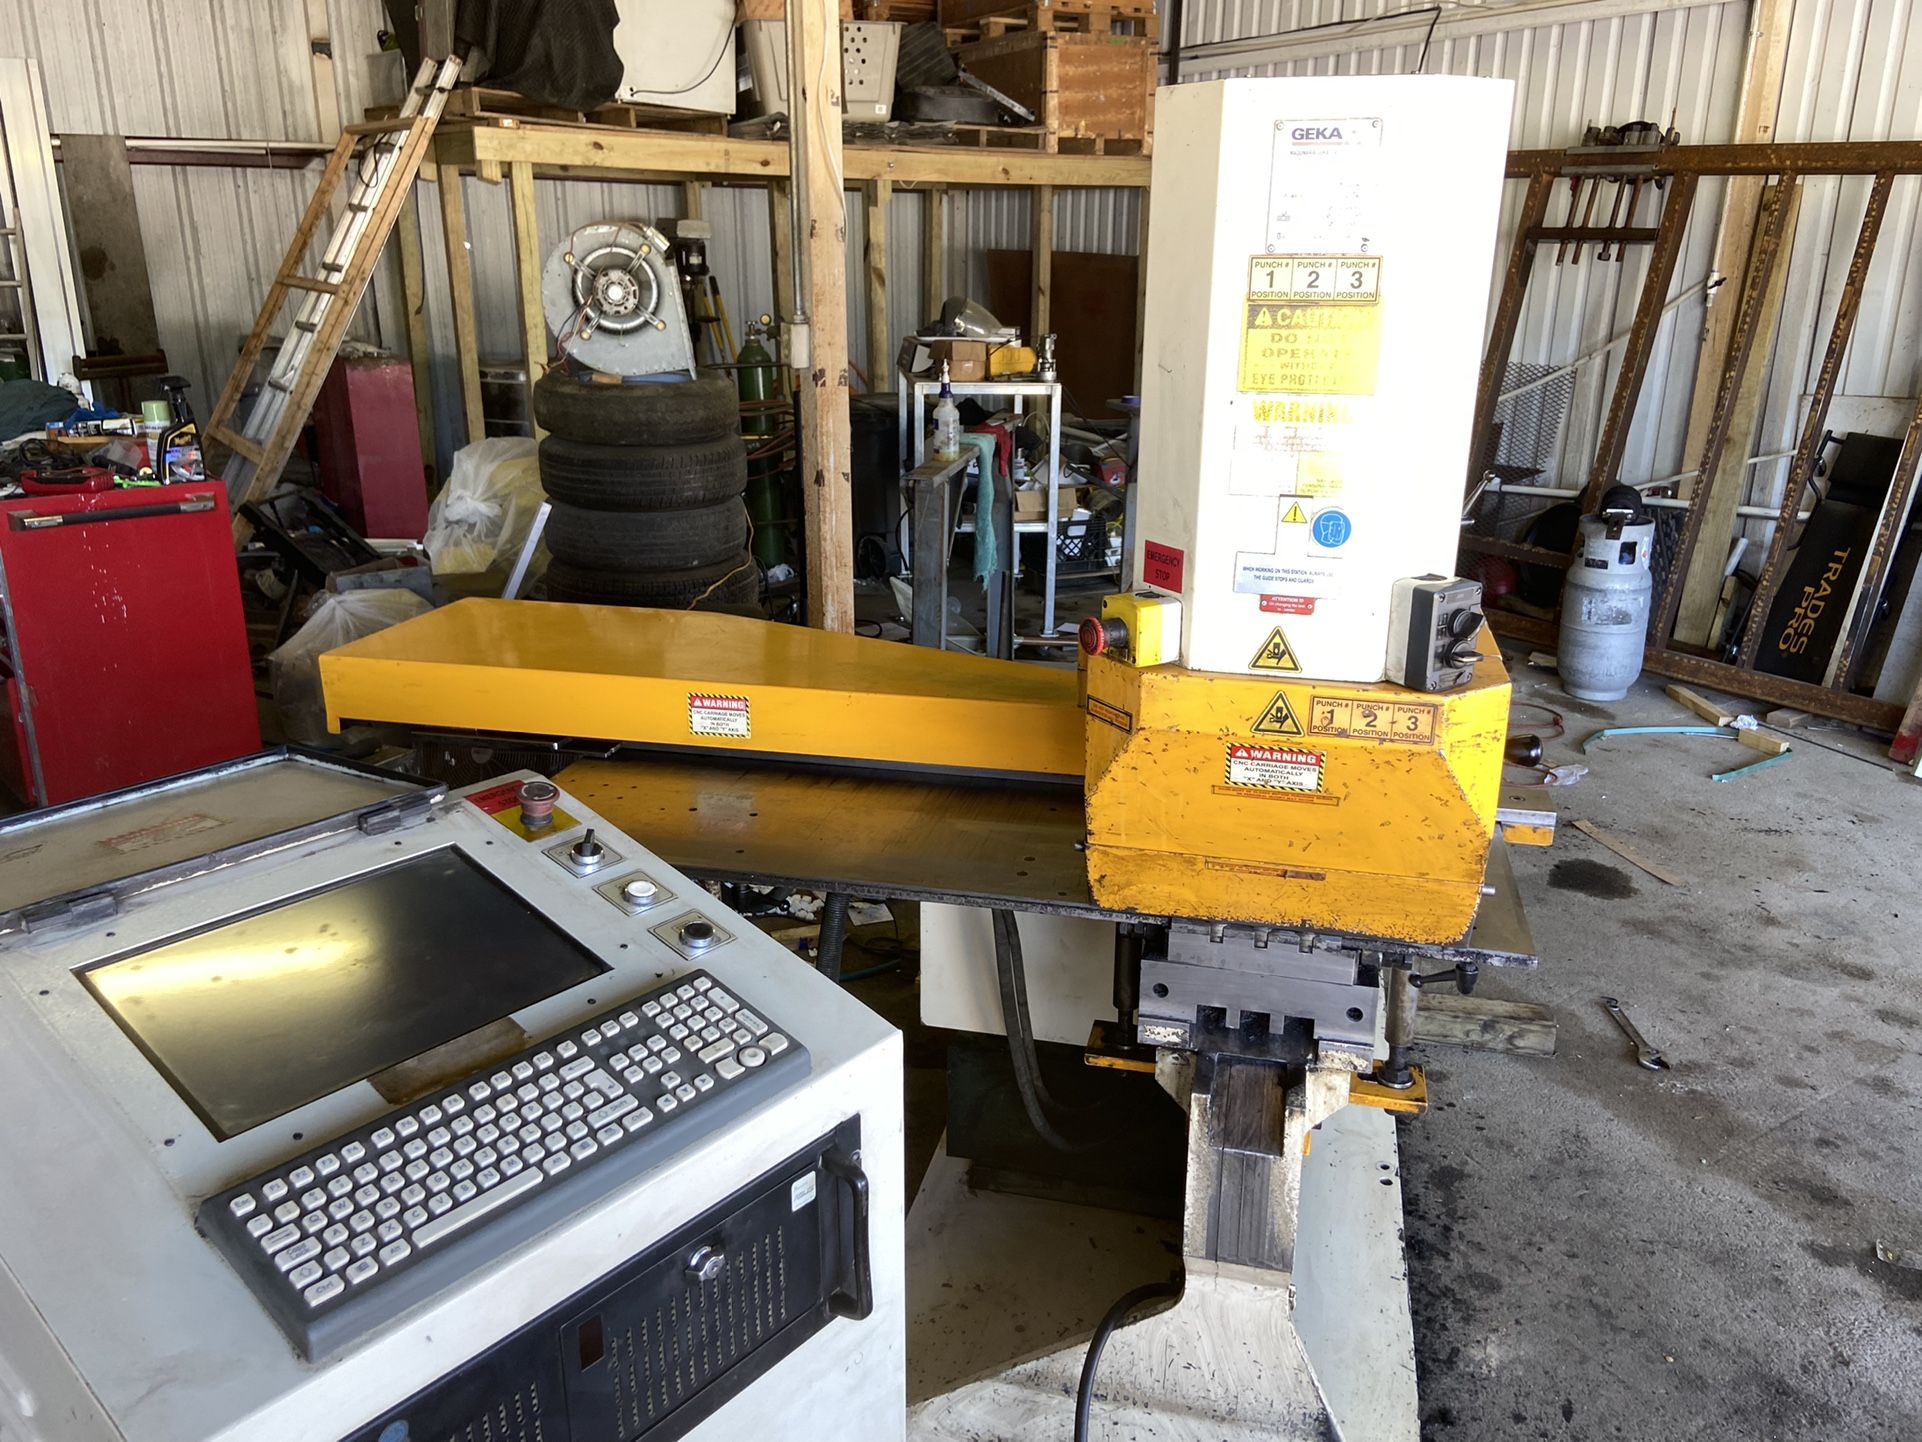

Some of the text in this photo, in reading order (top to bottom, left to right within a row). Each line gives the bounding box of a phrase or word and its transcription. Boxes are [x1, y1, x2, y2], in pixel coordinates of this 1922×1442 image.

[1292, 127, 1343, 140] GEKA
[1254, 261, 1283, 269] PUNCH
[1297, 261, 1326, 269] PUNCH
[1340, 261, 1369, 269] PUNCH
[1266, 270, 1274, 288] 1
[1307, 270, 1320, 288] 2
[1350, 270, 1363, 289] 3
[1251, 291, 1289, 299] POSITION
[1293, 291, 1332, 299] POSITION
[1146, 549, 1180, 568] EMERGENCY
[1155, 568, 1170, 582] STOP
[1788, 546, 1851, 655] TRADES
[1777, 585, 1816, 651] PRO
[702, 698, 744, 709] WARNING
[1316, 699, 1344, 708] PUNCH
[1356, 703, 1384, 712] PUNCH
[1398, 706, 1426, 715] PUNCH
[1364, 710, 1377, 728] 2
[1407, 715, 1420, 732] 3
[1312, 725, 1348, 734] POSITION
[1352, 728, 1389, 738] POSITION
[1393, 732, 1430, 741] POSITION
[1250, 749, 1317, 764] WARNING
[1252, 761, 1289, 770] CARRIAGE
[1244, 766, 1304, 777] AUTOMATICALLY
